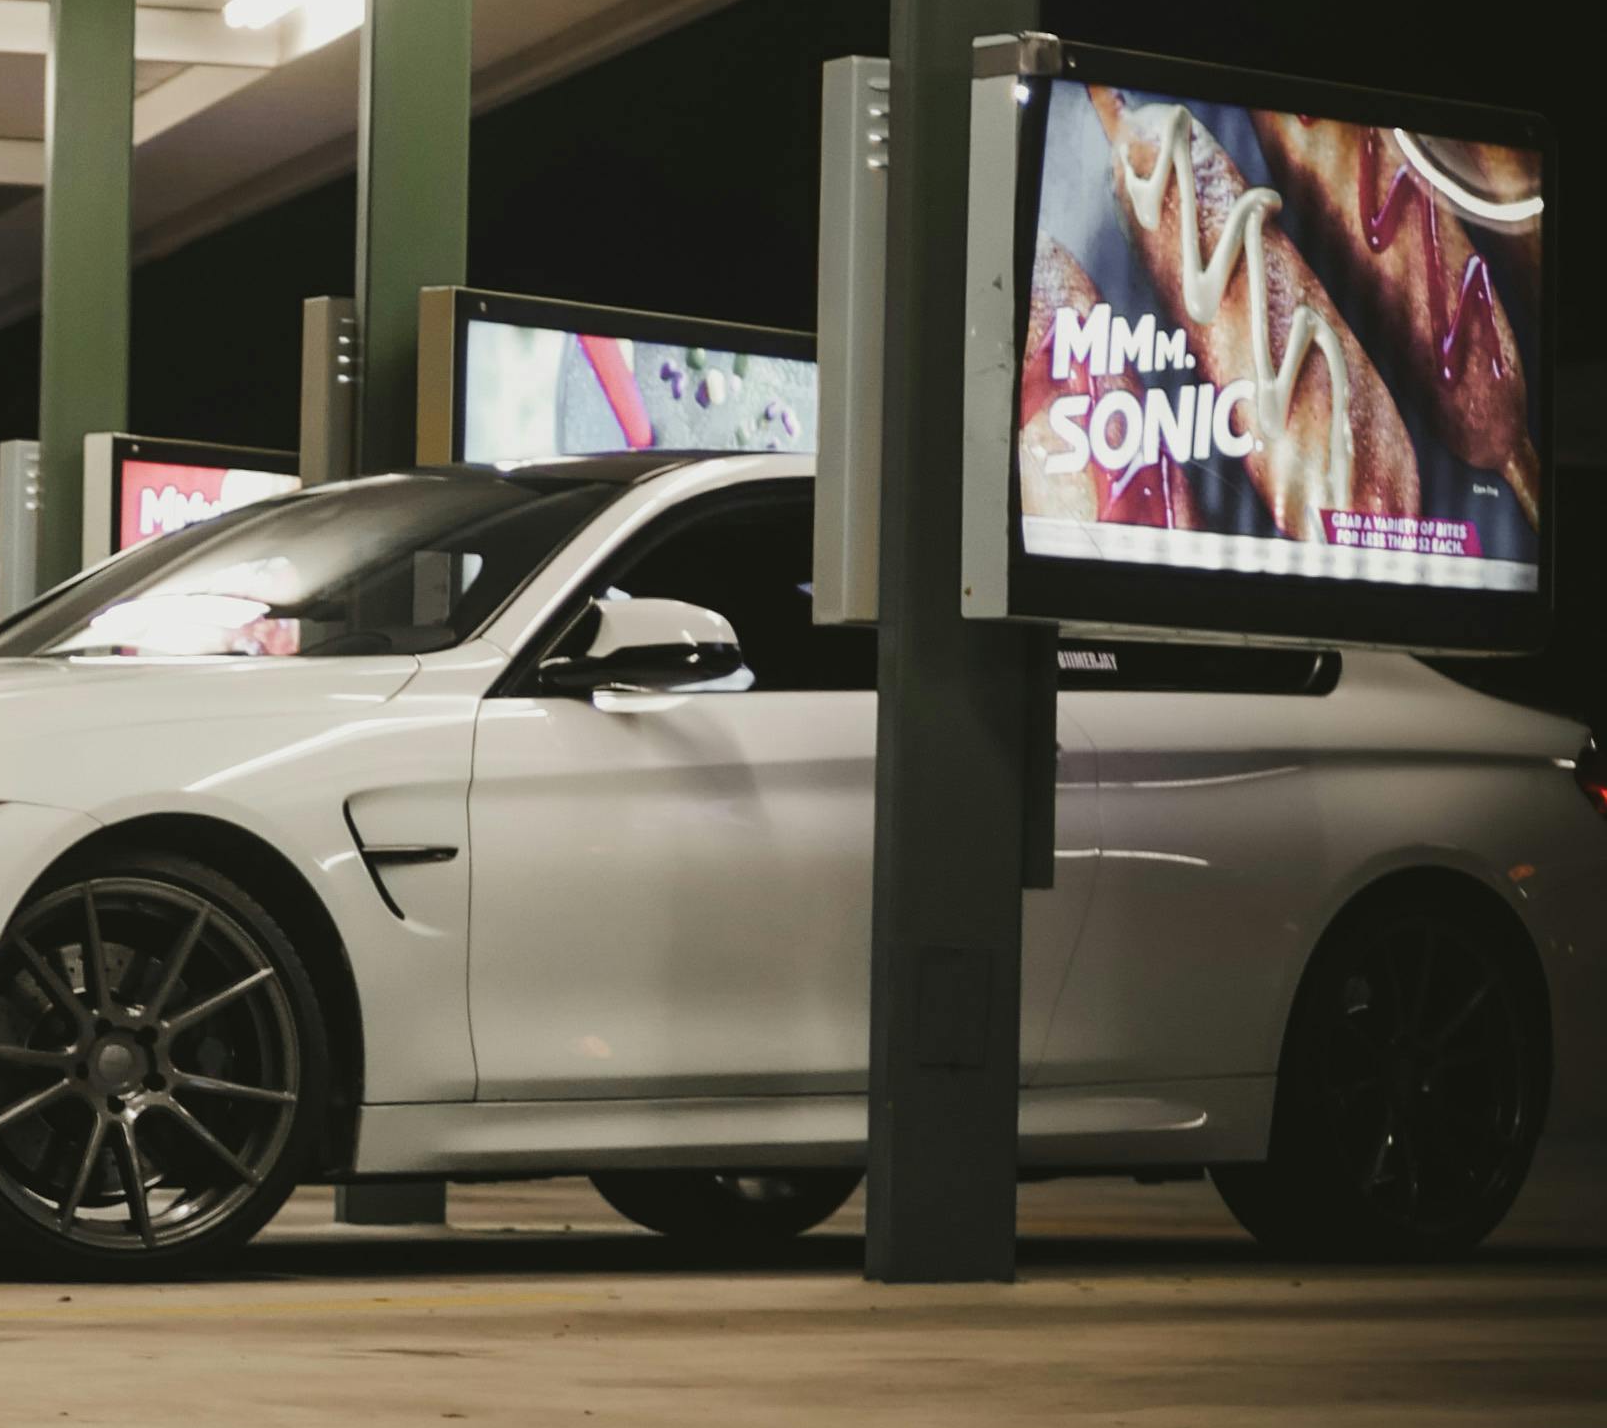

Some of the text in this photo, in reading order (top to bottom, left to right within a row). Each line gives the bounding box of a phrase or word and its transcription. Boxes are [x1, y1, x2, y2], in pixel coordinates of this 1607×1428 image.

[1331, 512, 1468, 540] GRAB A VARIETY OF BITES
[1335, 528, 1359, 544] FOR
[1361, 531, 1386, 548] LESS
[1387, 534, 1417, 551] THAN
